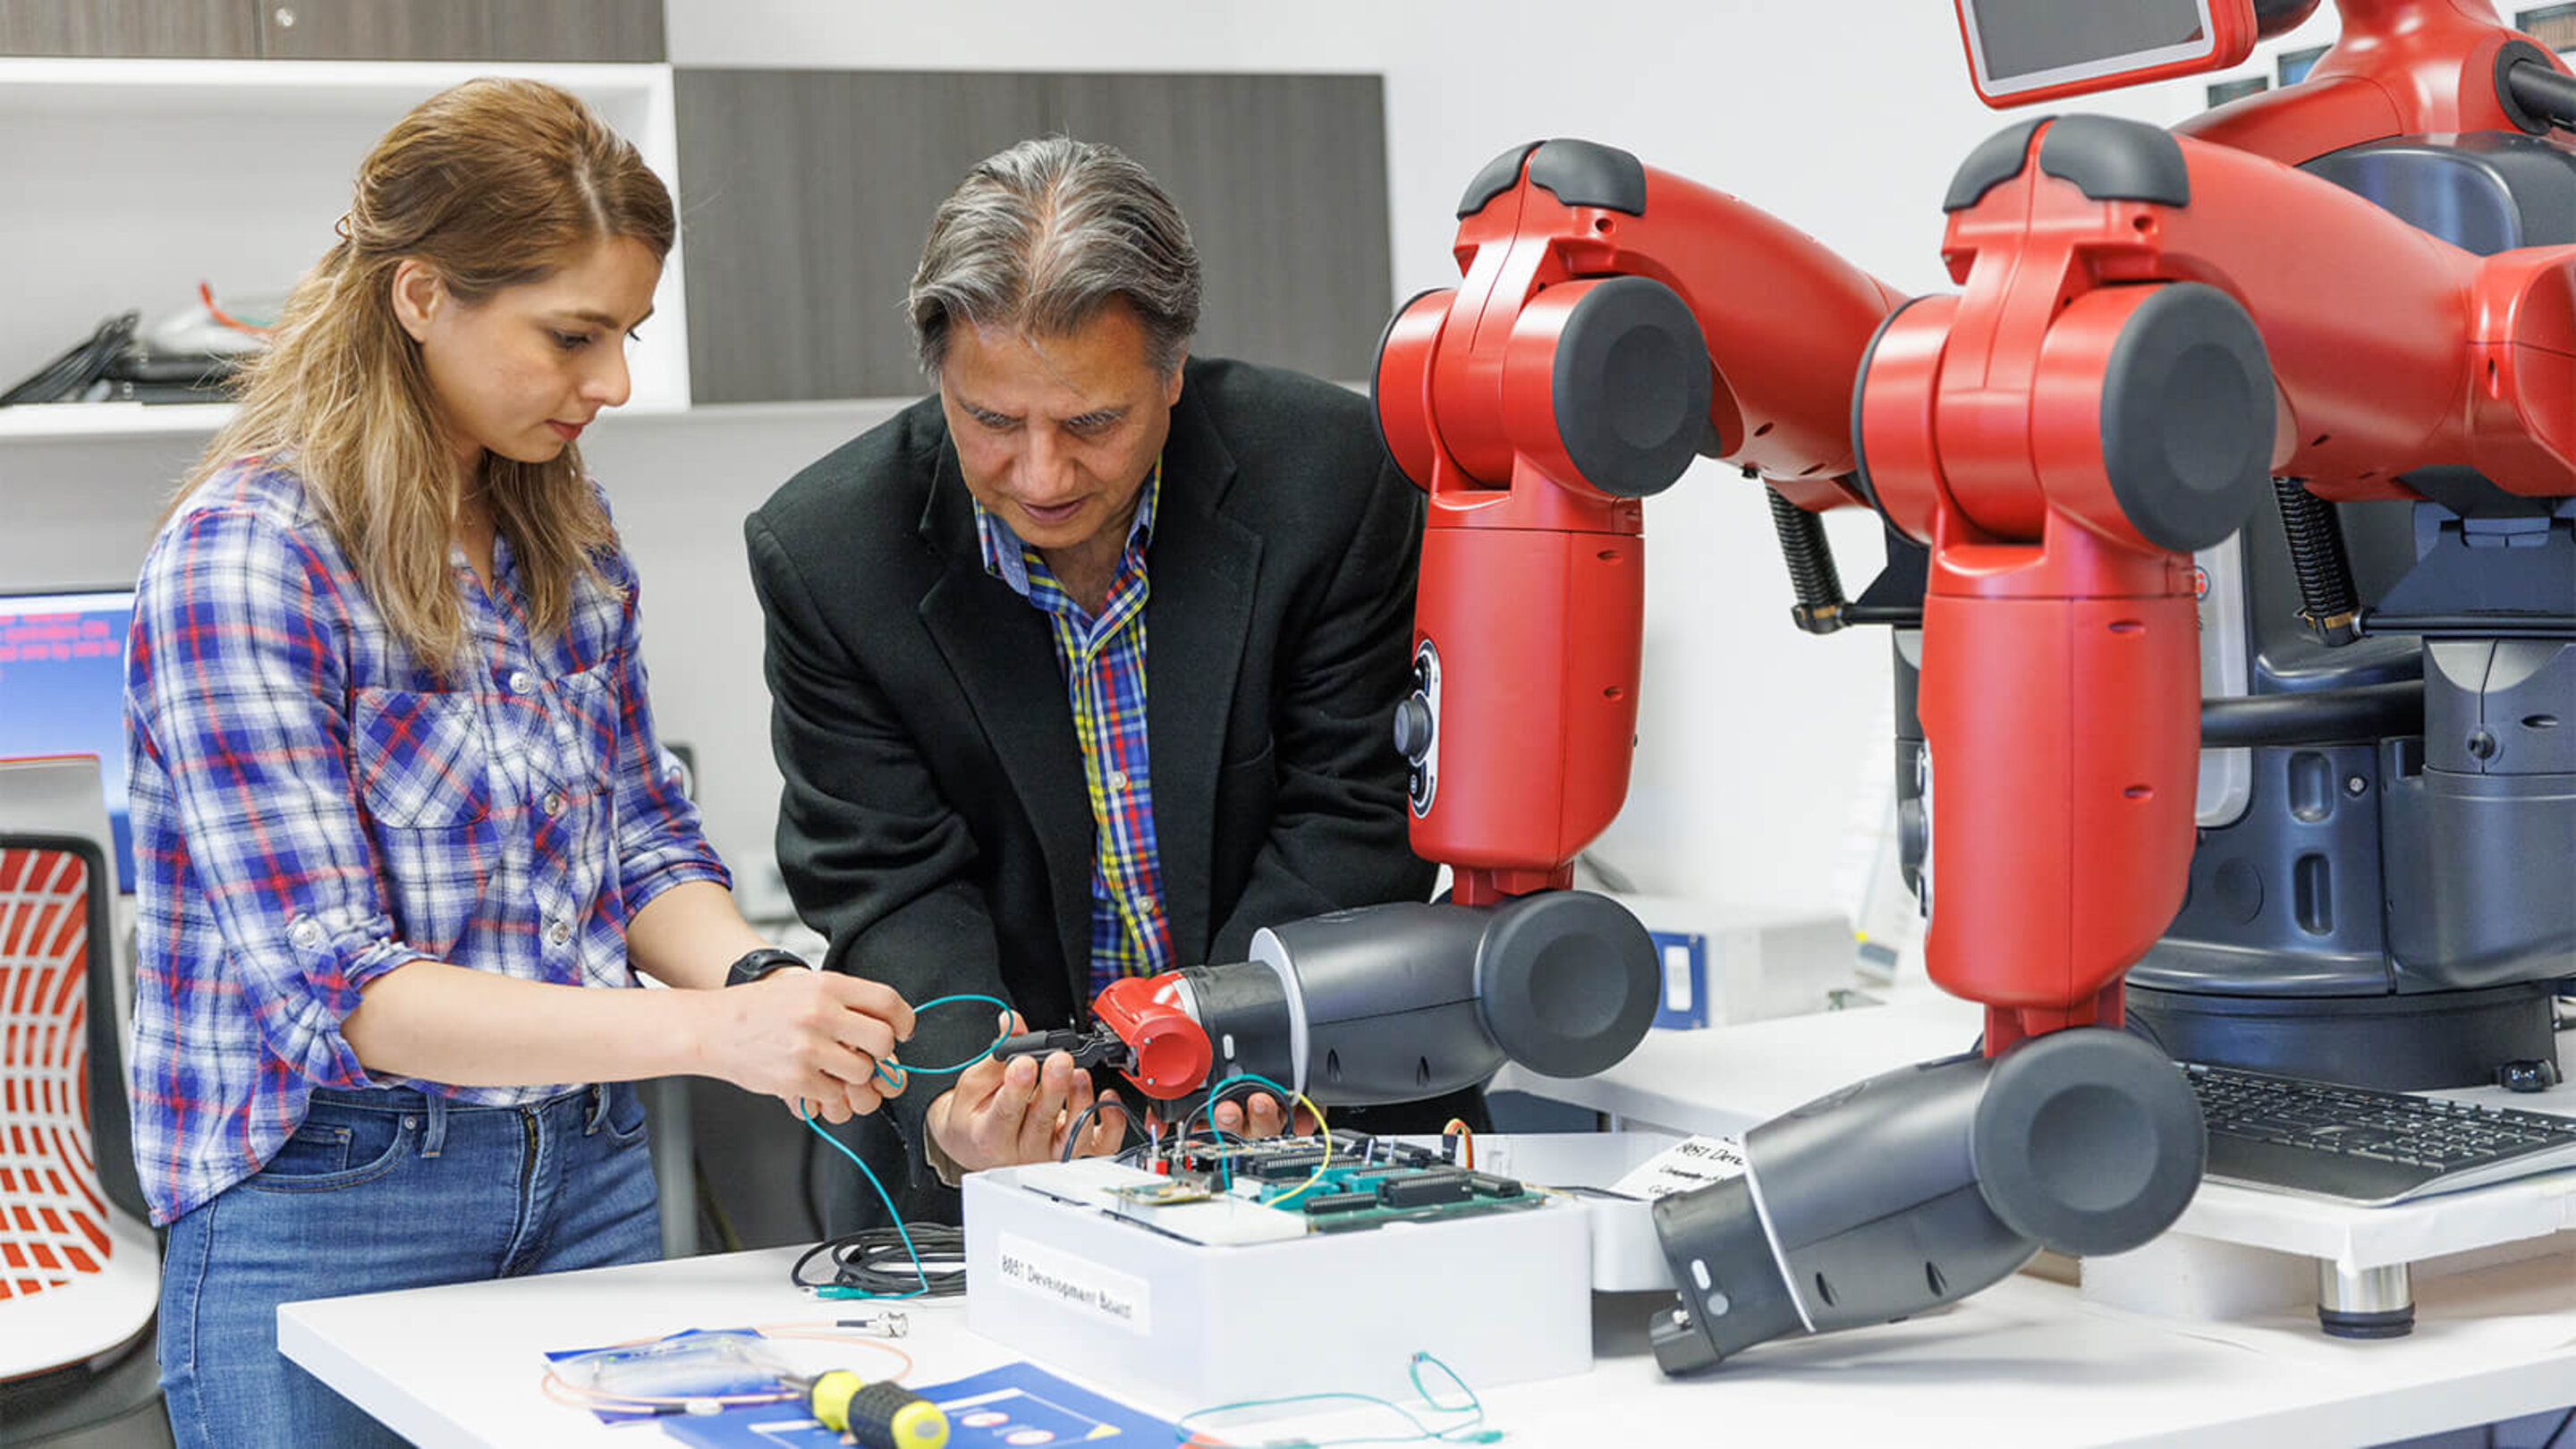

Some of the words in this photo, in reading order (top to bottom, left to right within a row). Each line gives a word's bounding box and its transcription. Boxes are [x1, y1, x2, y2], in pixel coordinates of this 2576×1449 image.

[1002, 1255, 1025, 1279] 8051
[1027, 1264, 1097, 1302] Development
[1099, 1291, 1132, 1319] Board
